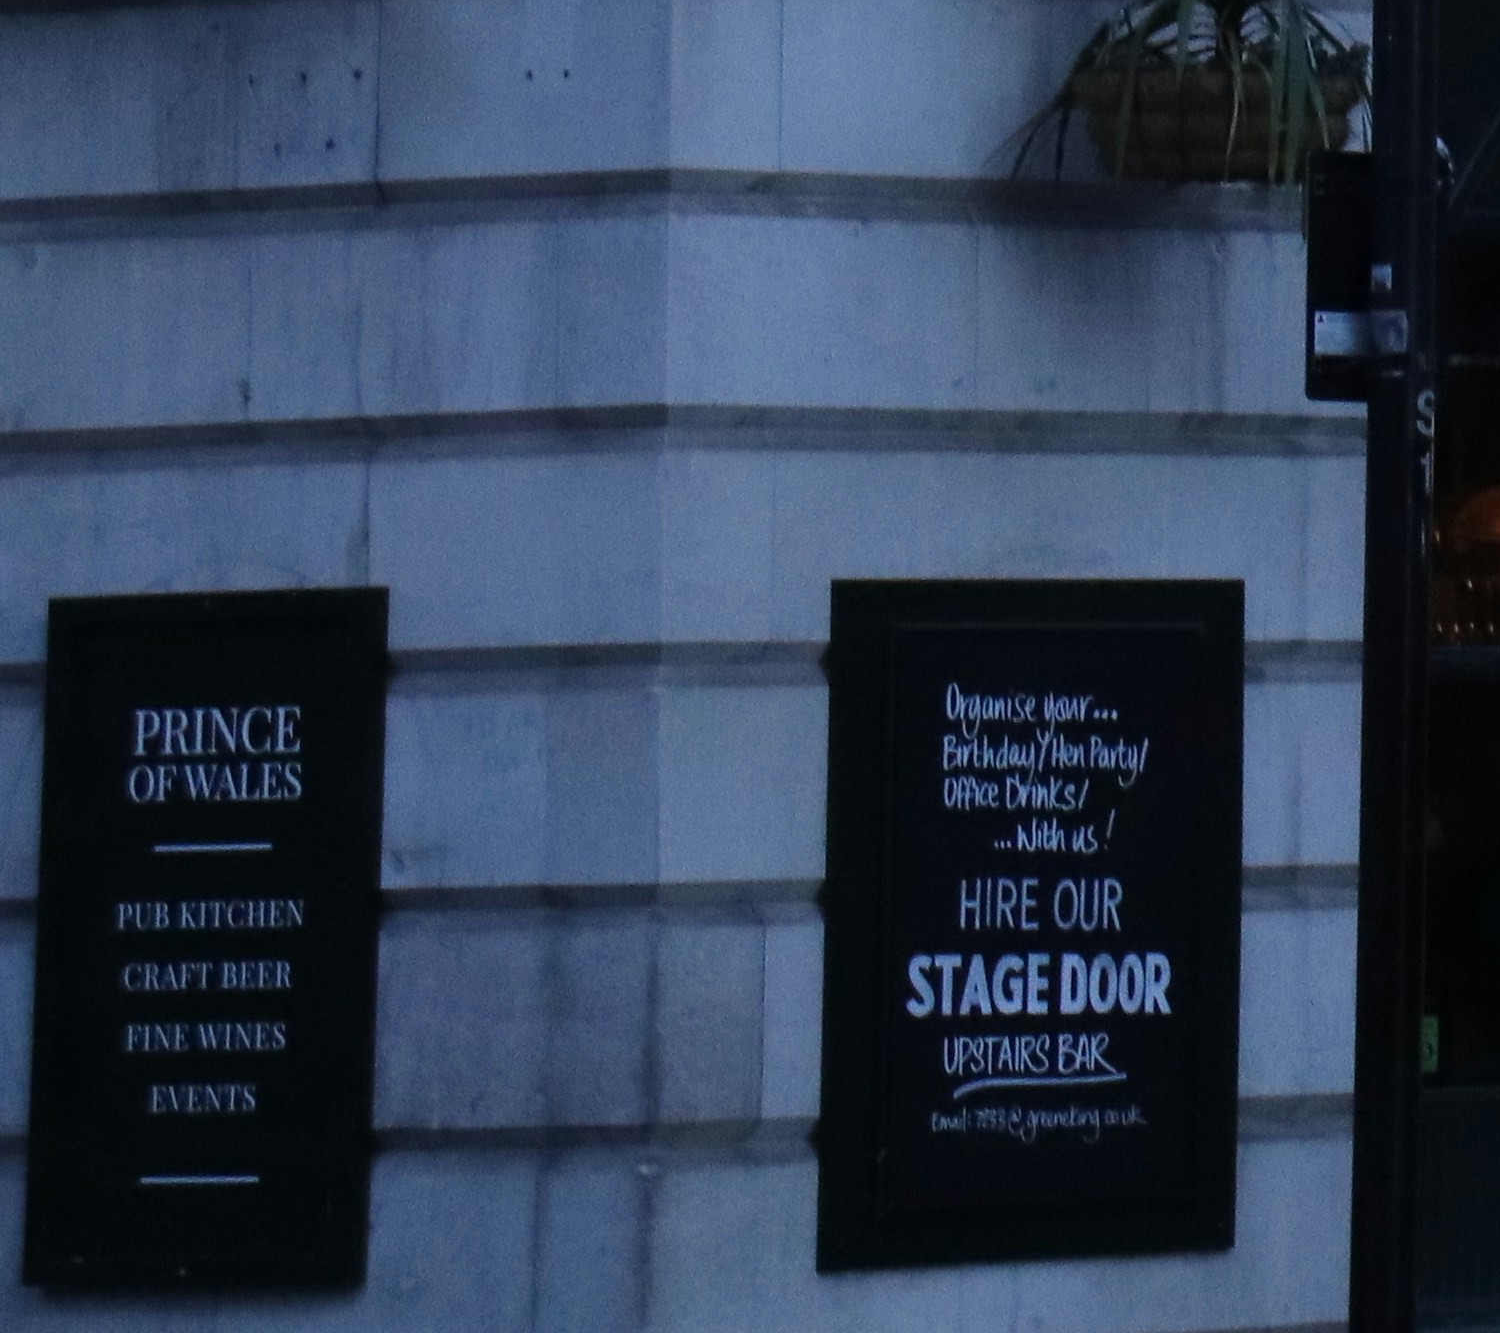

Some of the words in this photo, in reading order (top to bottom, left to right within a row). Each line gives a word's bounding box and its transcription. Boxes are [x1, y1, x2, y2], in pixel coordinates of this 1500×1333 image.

[132, 704, 302, 757] PRINCE
[945, 681, 1038, 740] Organise
[128, 764, 177, 803] OF
[183, 761, 303, 802] WALES
[943, 774, 1000, 811] Office
[115, 900, 170, 930] PUB
[178, 898, 305, 928] KITCHEN
[959, 876, 1040, 932] HIRE
[1053, 876, 1124, 932] OUR
[122, 962, 214, 991] CRAFT
[220, 959, 292, 989] BEER
[905, 951, 1051, 1019] STAGE
[1059, 950, 1173, 1016] DOOR
[124, 1022, 189, 1052] FINE
[197, 1021, 287, 1051] WINES
[943, 1033, 1051, 1076] UPSTAIRS
[1057, 1032, 1119, 1076] BAR
[149, 1084, 258, 1113] EVENTS
